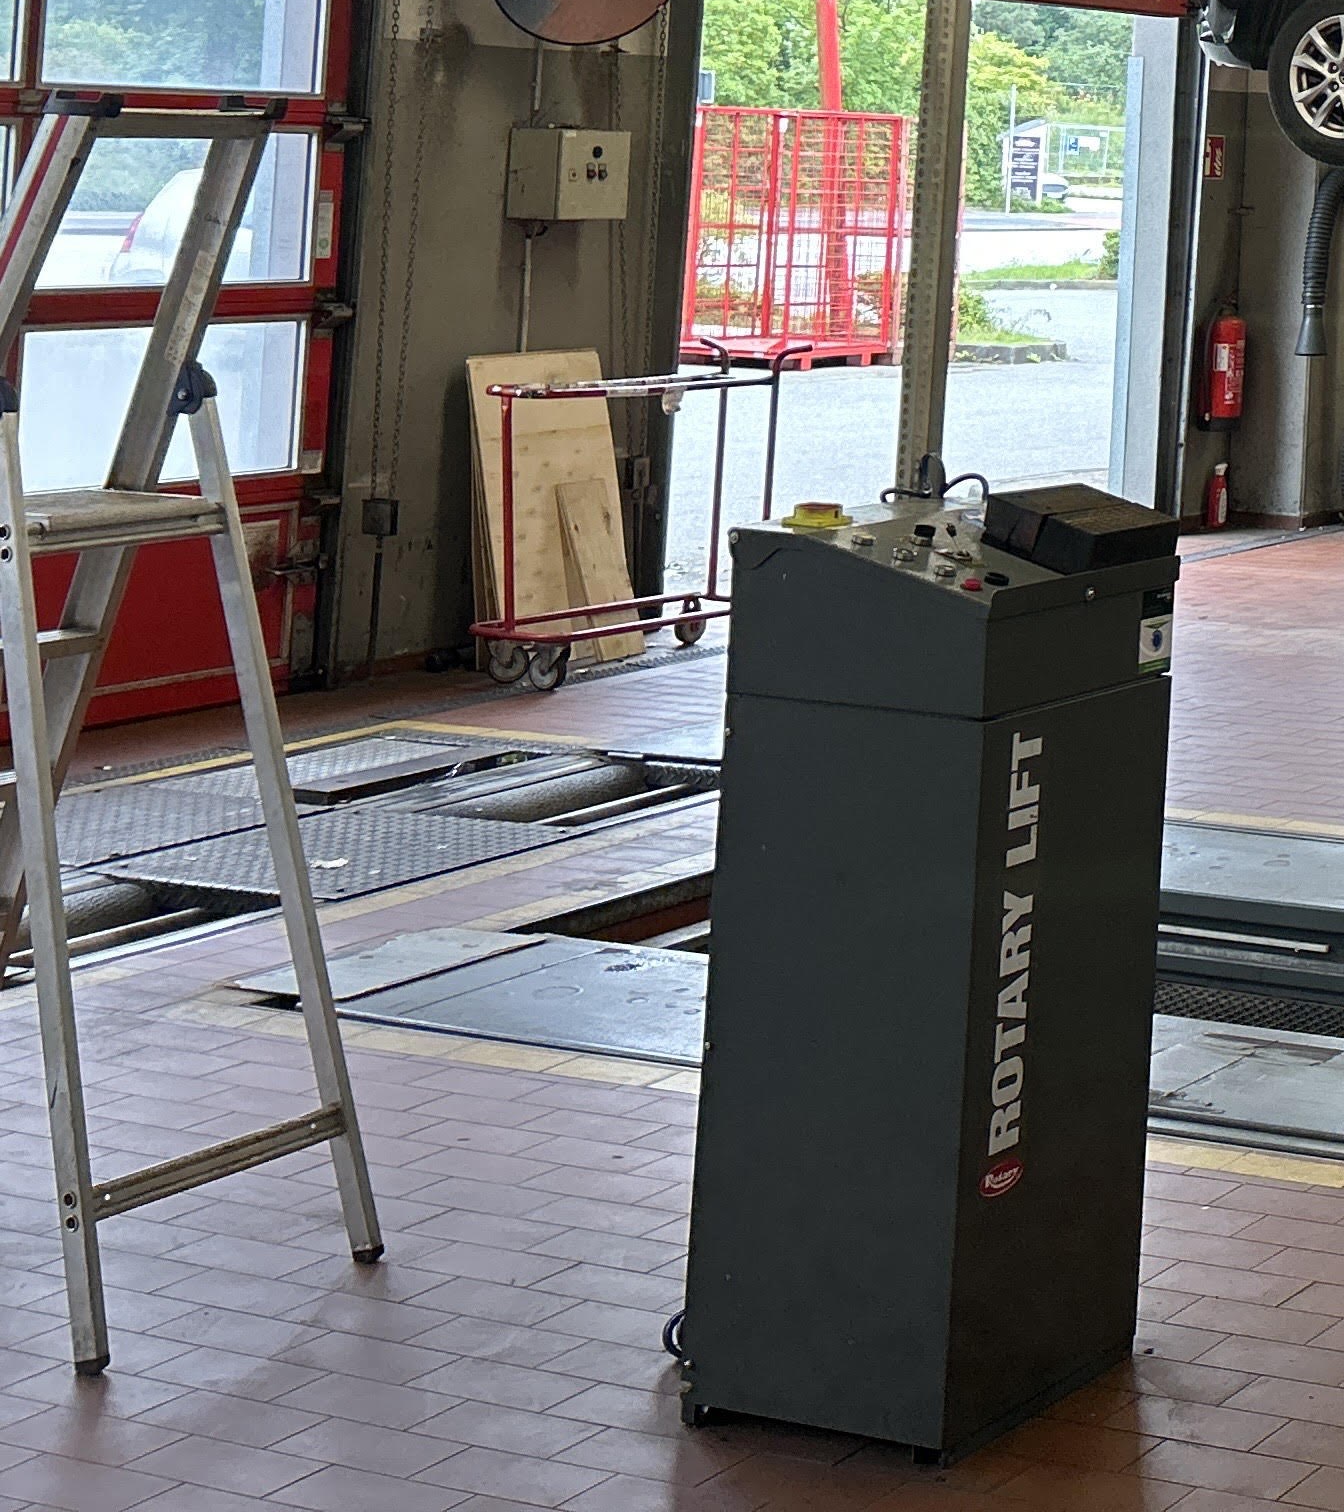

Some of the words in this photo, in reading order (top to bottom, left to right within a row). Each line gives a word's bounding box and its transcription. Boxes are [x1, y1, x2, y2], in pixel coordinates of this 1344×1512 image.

[1006, 732, 1043, 868] LIFT
[987, 890, 1034, 1156] ROTARY
[984, 1165, 1020, 1190] Rotary
